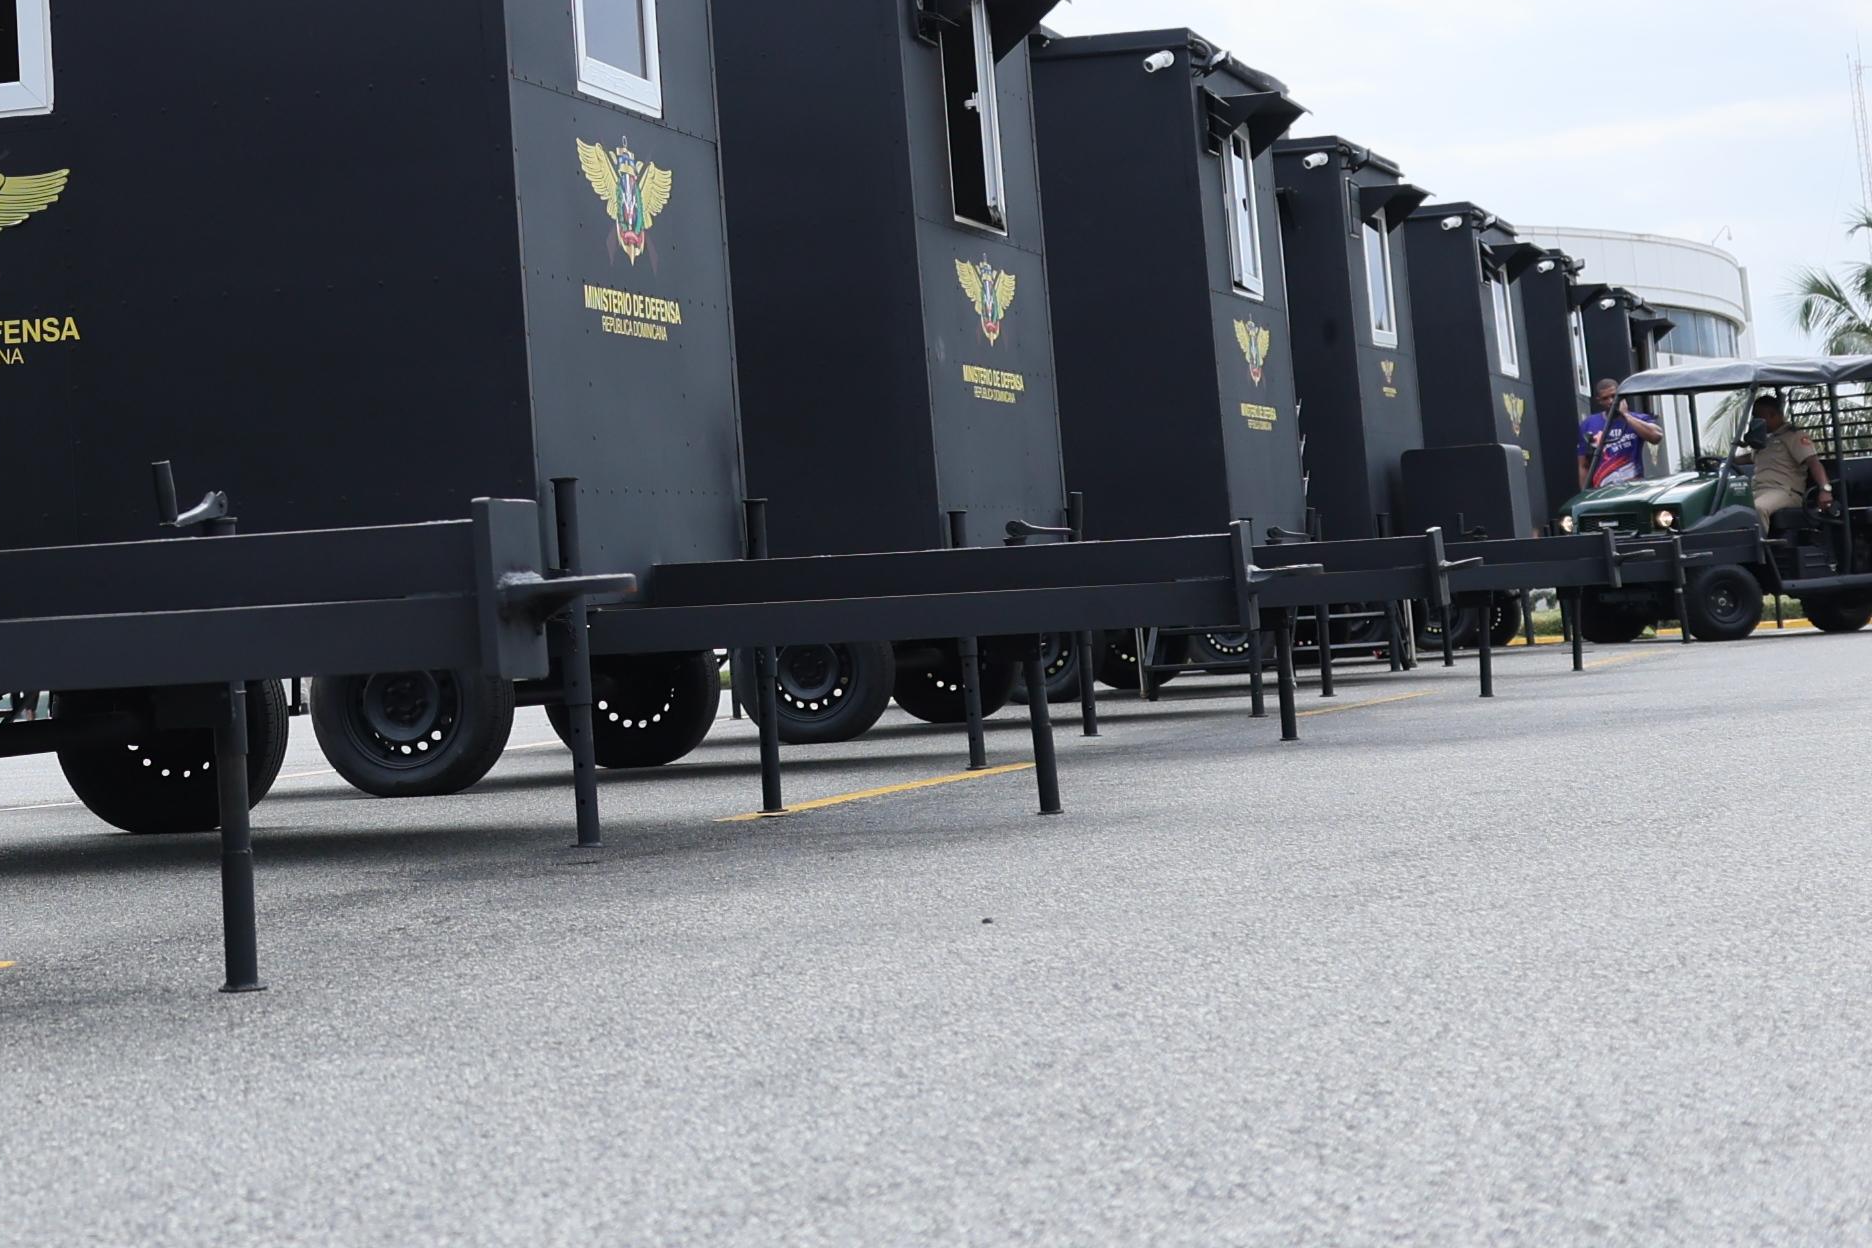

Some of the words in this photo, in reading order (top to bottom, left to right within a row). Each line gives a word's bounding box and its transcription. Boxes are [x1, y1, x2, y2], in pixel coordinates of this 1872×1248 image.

[584, 284, 632, 316] MINISTERIO
[633, 294, 645, 318] DE
[645, 296, 682, 325] DEFENSA
